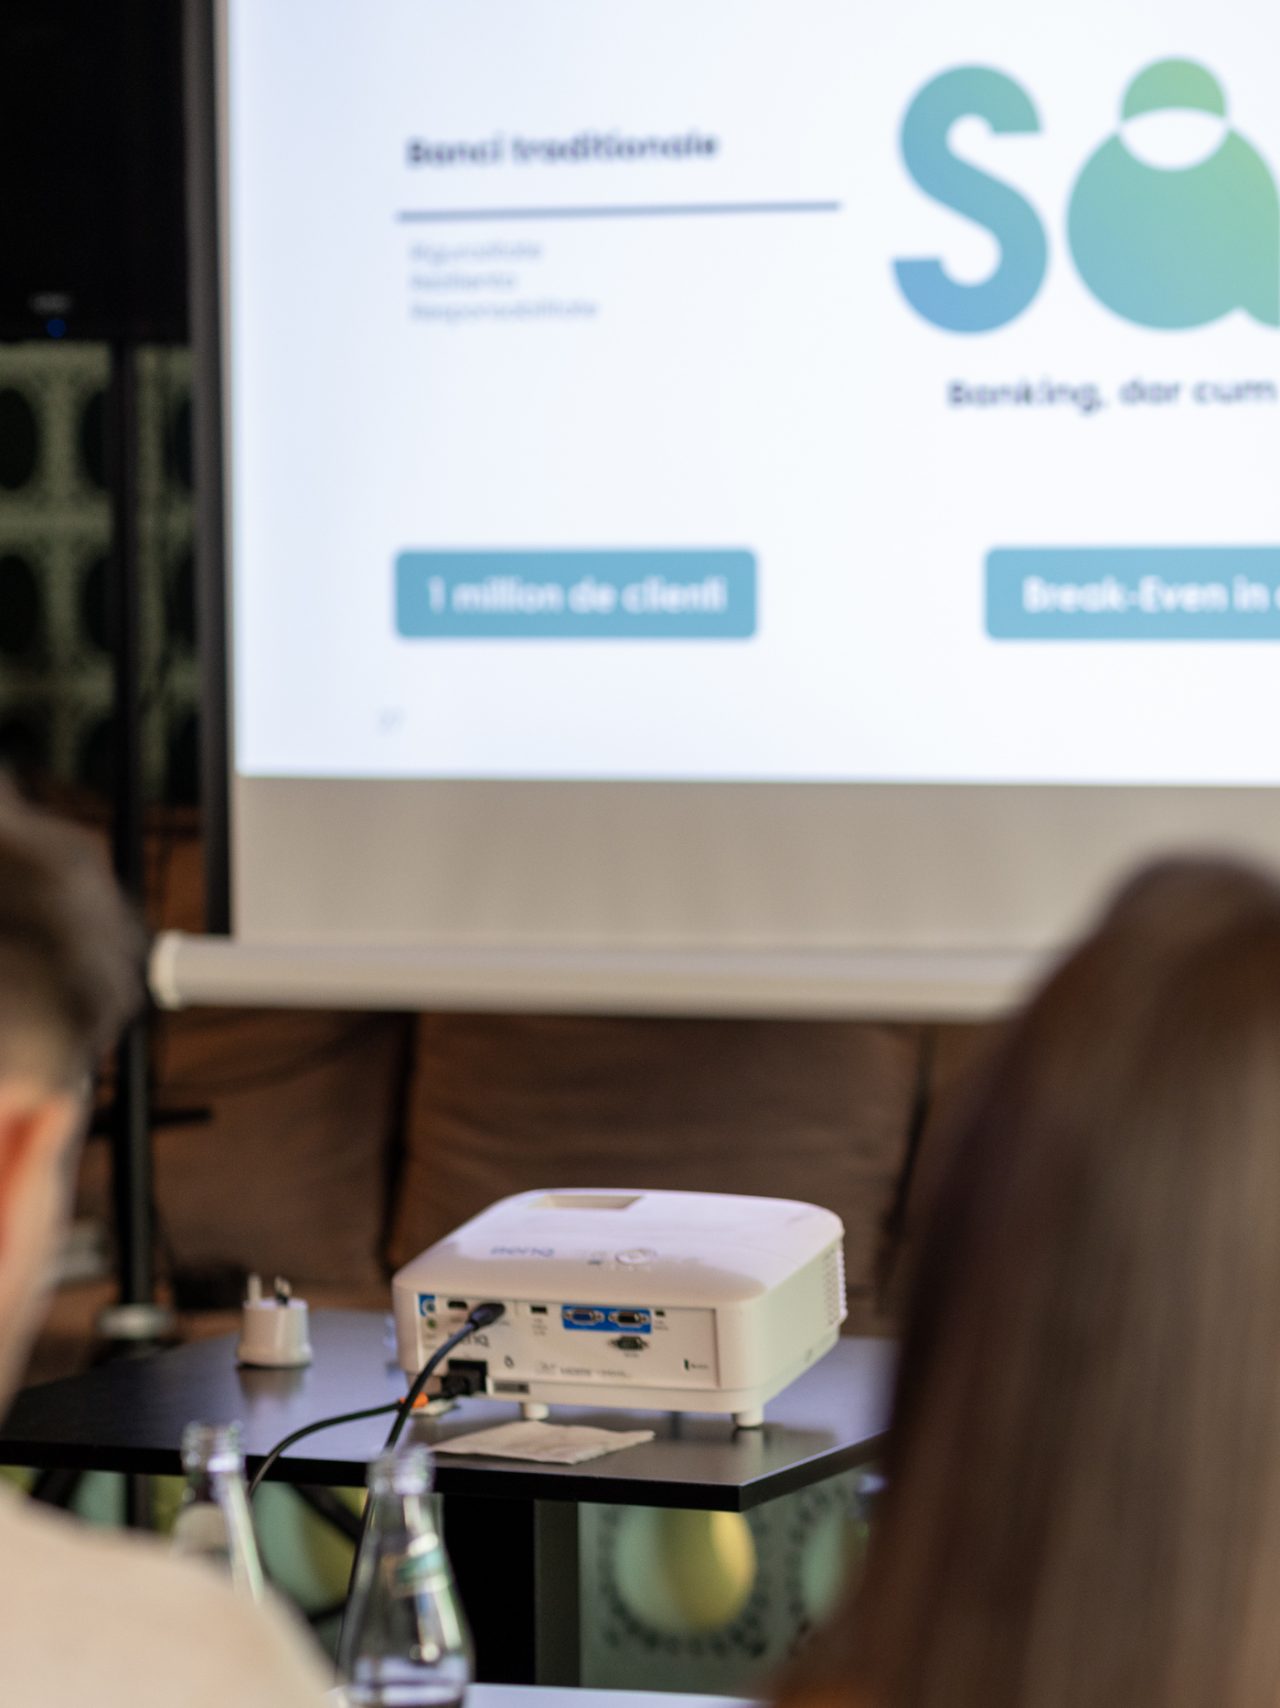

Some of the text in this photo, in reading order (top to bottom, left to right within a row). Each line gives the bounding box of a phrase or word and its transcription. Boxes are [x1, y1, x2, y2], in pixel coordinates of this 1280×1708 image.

[1193, 379, 1277, 404] cum
[428, 576, 446, 614] 1
[568, 575, 617, 614] de
[1022, 575, 1228, 613] Break-Even
[1234, 576, 1270, 612] in
